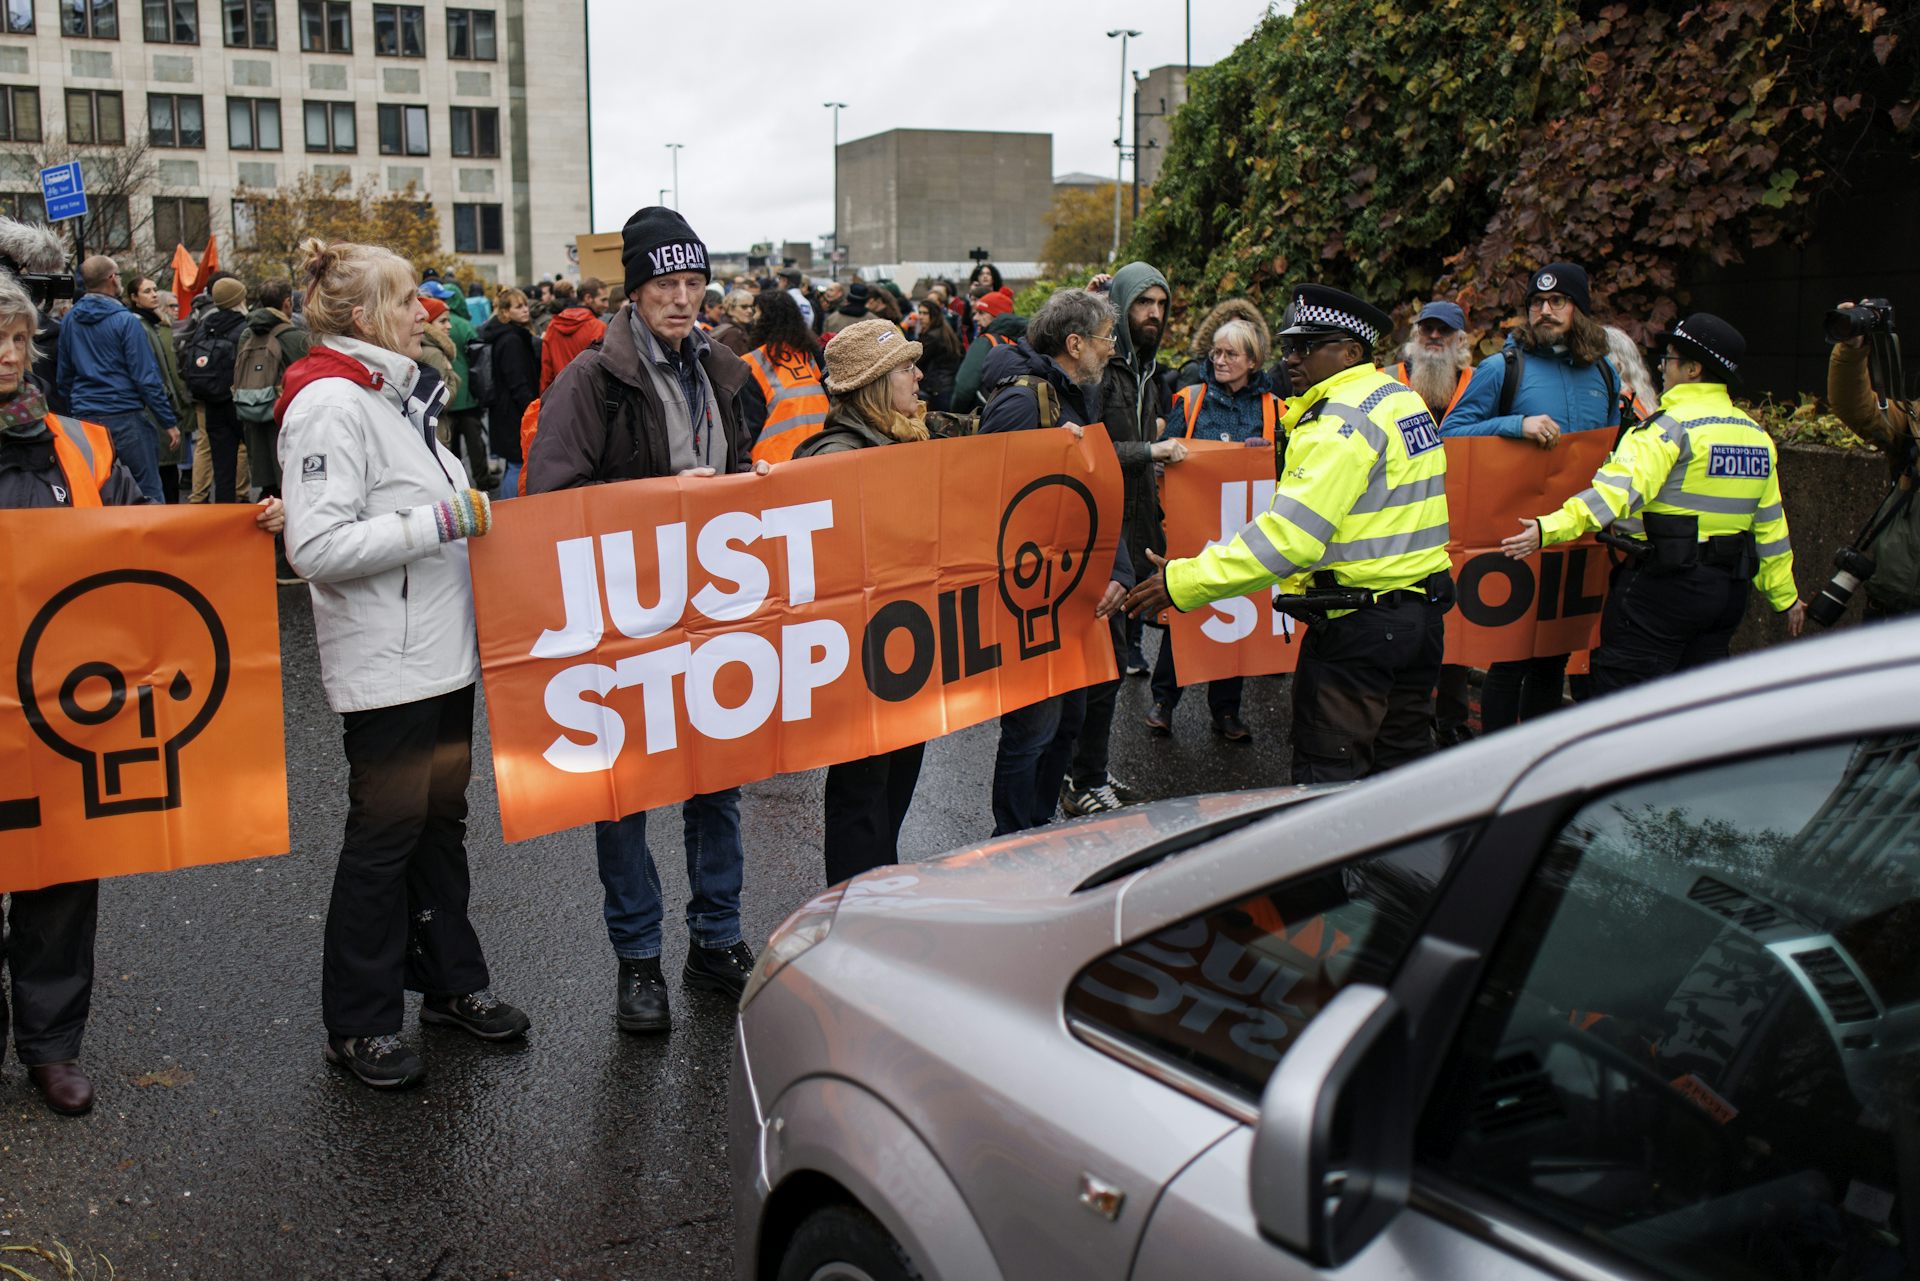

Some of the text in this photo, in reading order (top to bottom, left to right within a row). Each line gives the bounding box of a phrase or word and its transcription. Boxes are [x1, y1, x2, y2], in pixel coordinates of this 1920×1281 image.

[647, 242, 706, 271] VEGAN
[1403, 422, 1442, 454] POLIC
[1712, 446, 1769, 456] METROPOLITAN
[1710, 455, 1770, 476] POLICE
[529, 499, 834, 659] JUST
[1456, 547, 1605, 628] OIL
[542, 584, 1003, 774] STOP OIL
